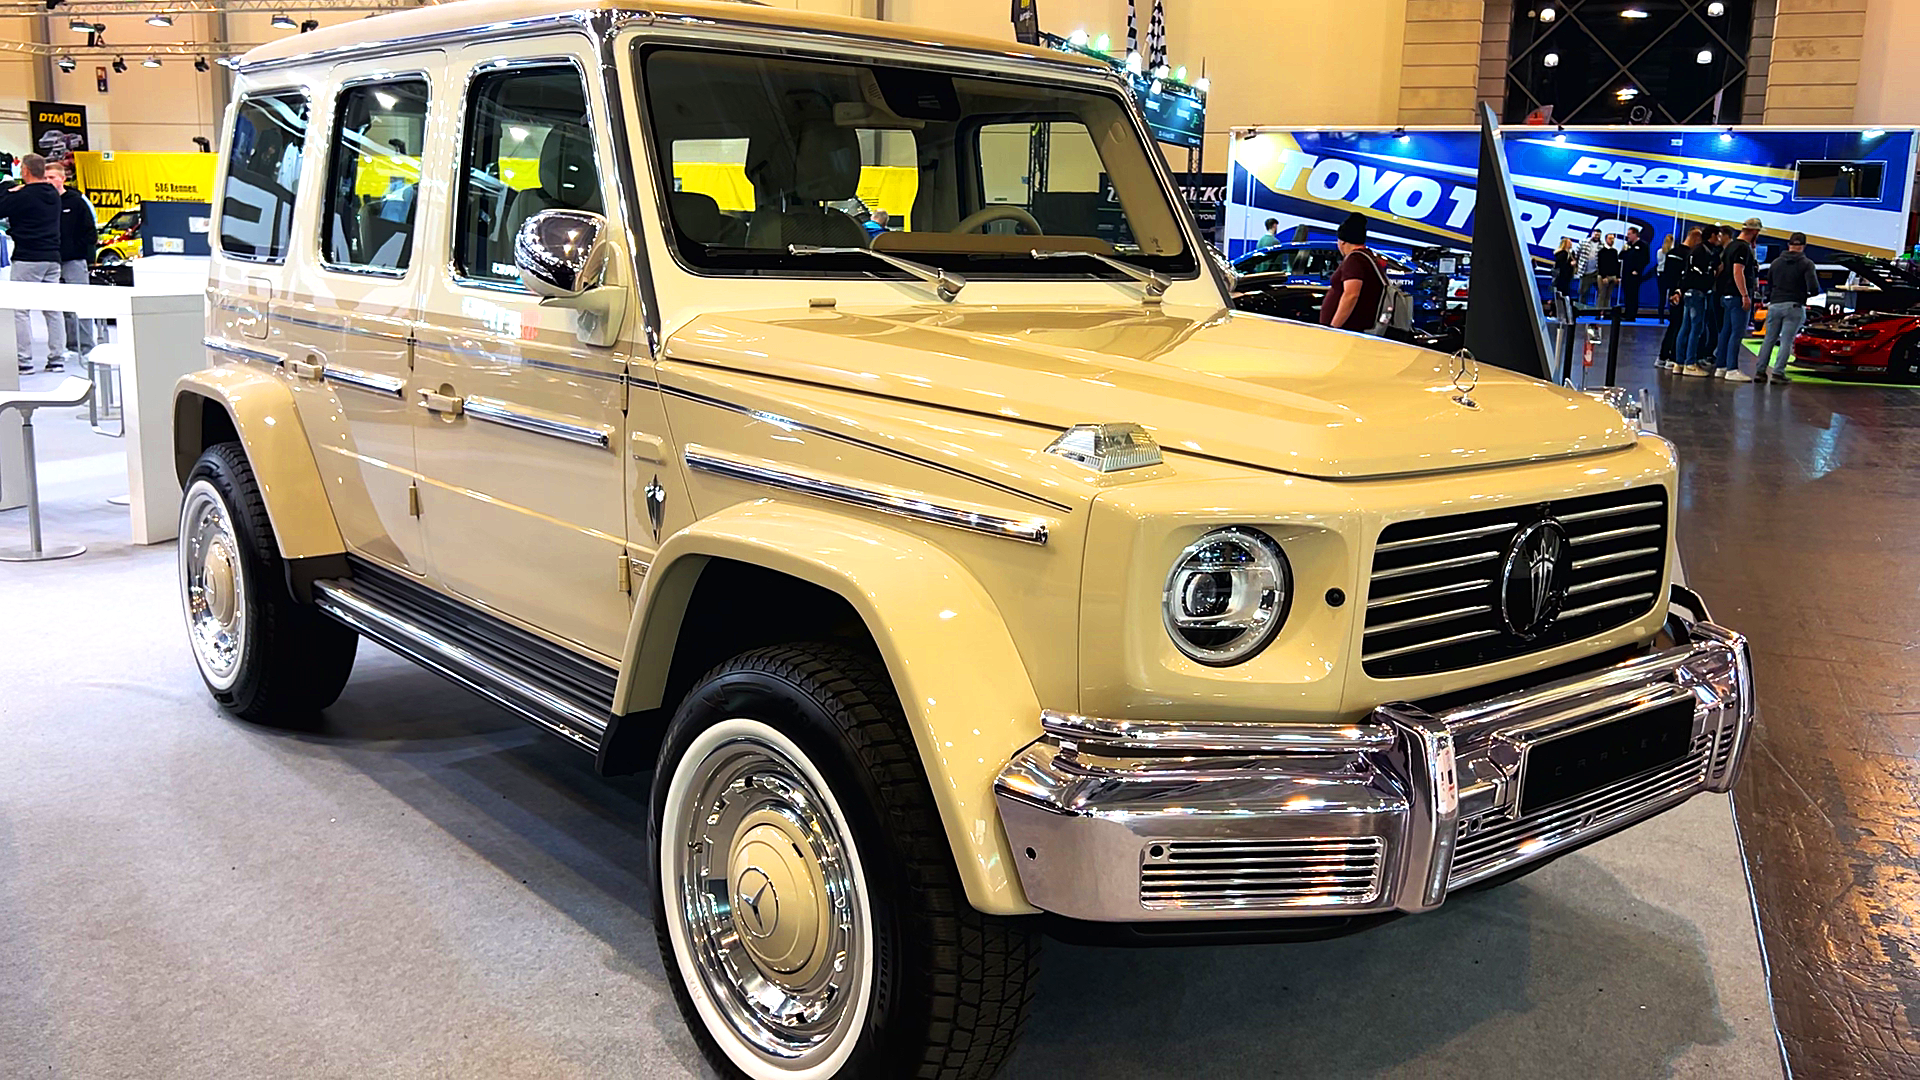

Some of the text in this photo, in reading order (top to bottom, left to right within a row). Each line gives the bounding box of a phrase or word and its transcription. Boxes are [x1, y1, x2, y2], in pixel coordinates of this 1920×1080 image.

[38, 113, 79, 125] DTM 40
[1568, 156, 1792, 205] PROXES
[89, 191, 141, 206] DTM 40
[1275, 148, 1643, 252] TOYO TRE
